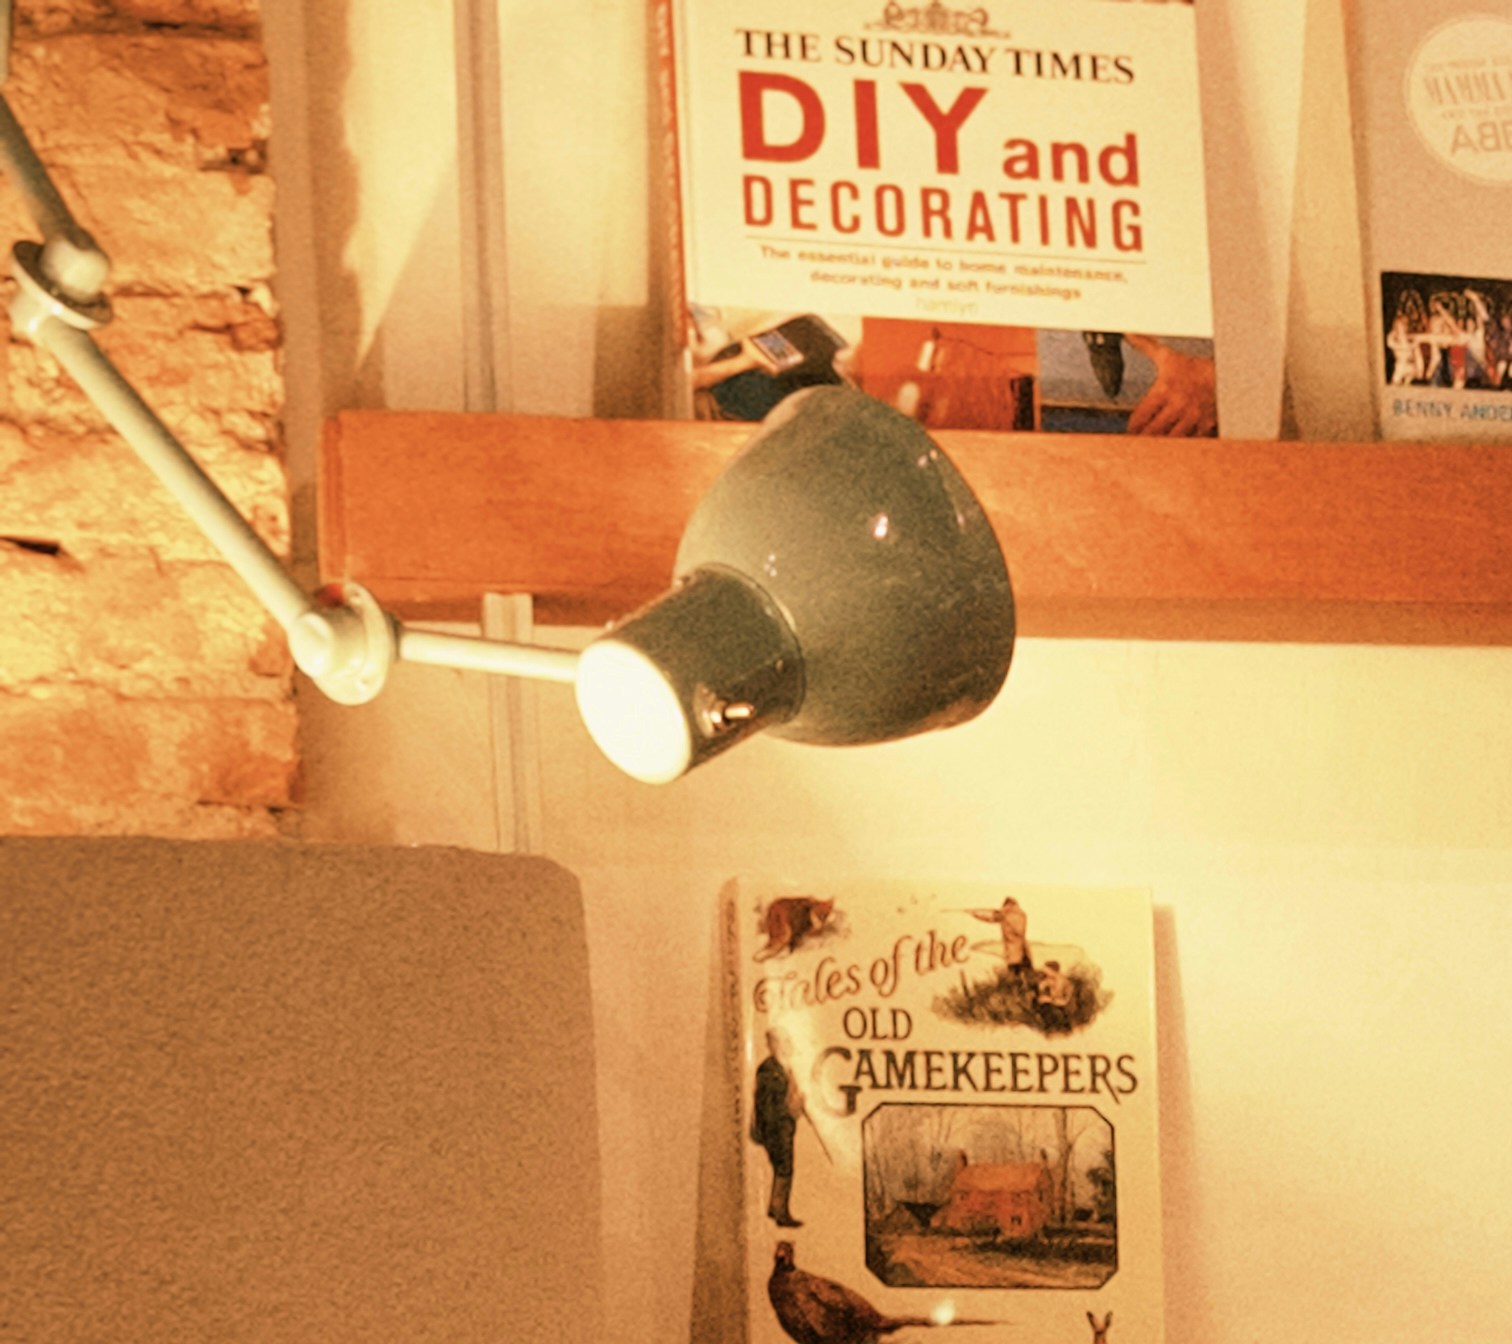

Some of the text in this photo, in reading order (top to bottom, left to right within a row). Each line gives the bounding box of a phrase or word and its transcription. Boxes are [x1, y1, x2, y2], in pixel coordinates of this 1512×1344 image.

[735, 30, 1135, 85] THE SUNDAY TIMES
[738, 70, 1140, 187] DIY and
[743, 174, 1144, 252] DECORATING
[760, 245, 791, 261] The
[798, 249, 876, 267] essential
[882, 254, 930, 272] guide
[935, 258, 954, 272] to
[959, 260, 1006, 276] home
[810, 270, 1082, 301] decorating and soft furnishings
[1393, 400, 1454, 419] BENNY
[754, 929, 972, 1013] Tales of the
[842, 1007, 913, 1042] OLD
[811, 1046, 1139, 1118] GAMEKEEPERS
